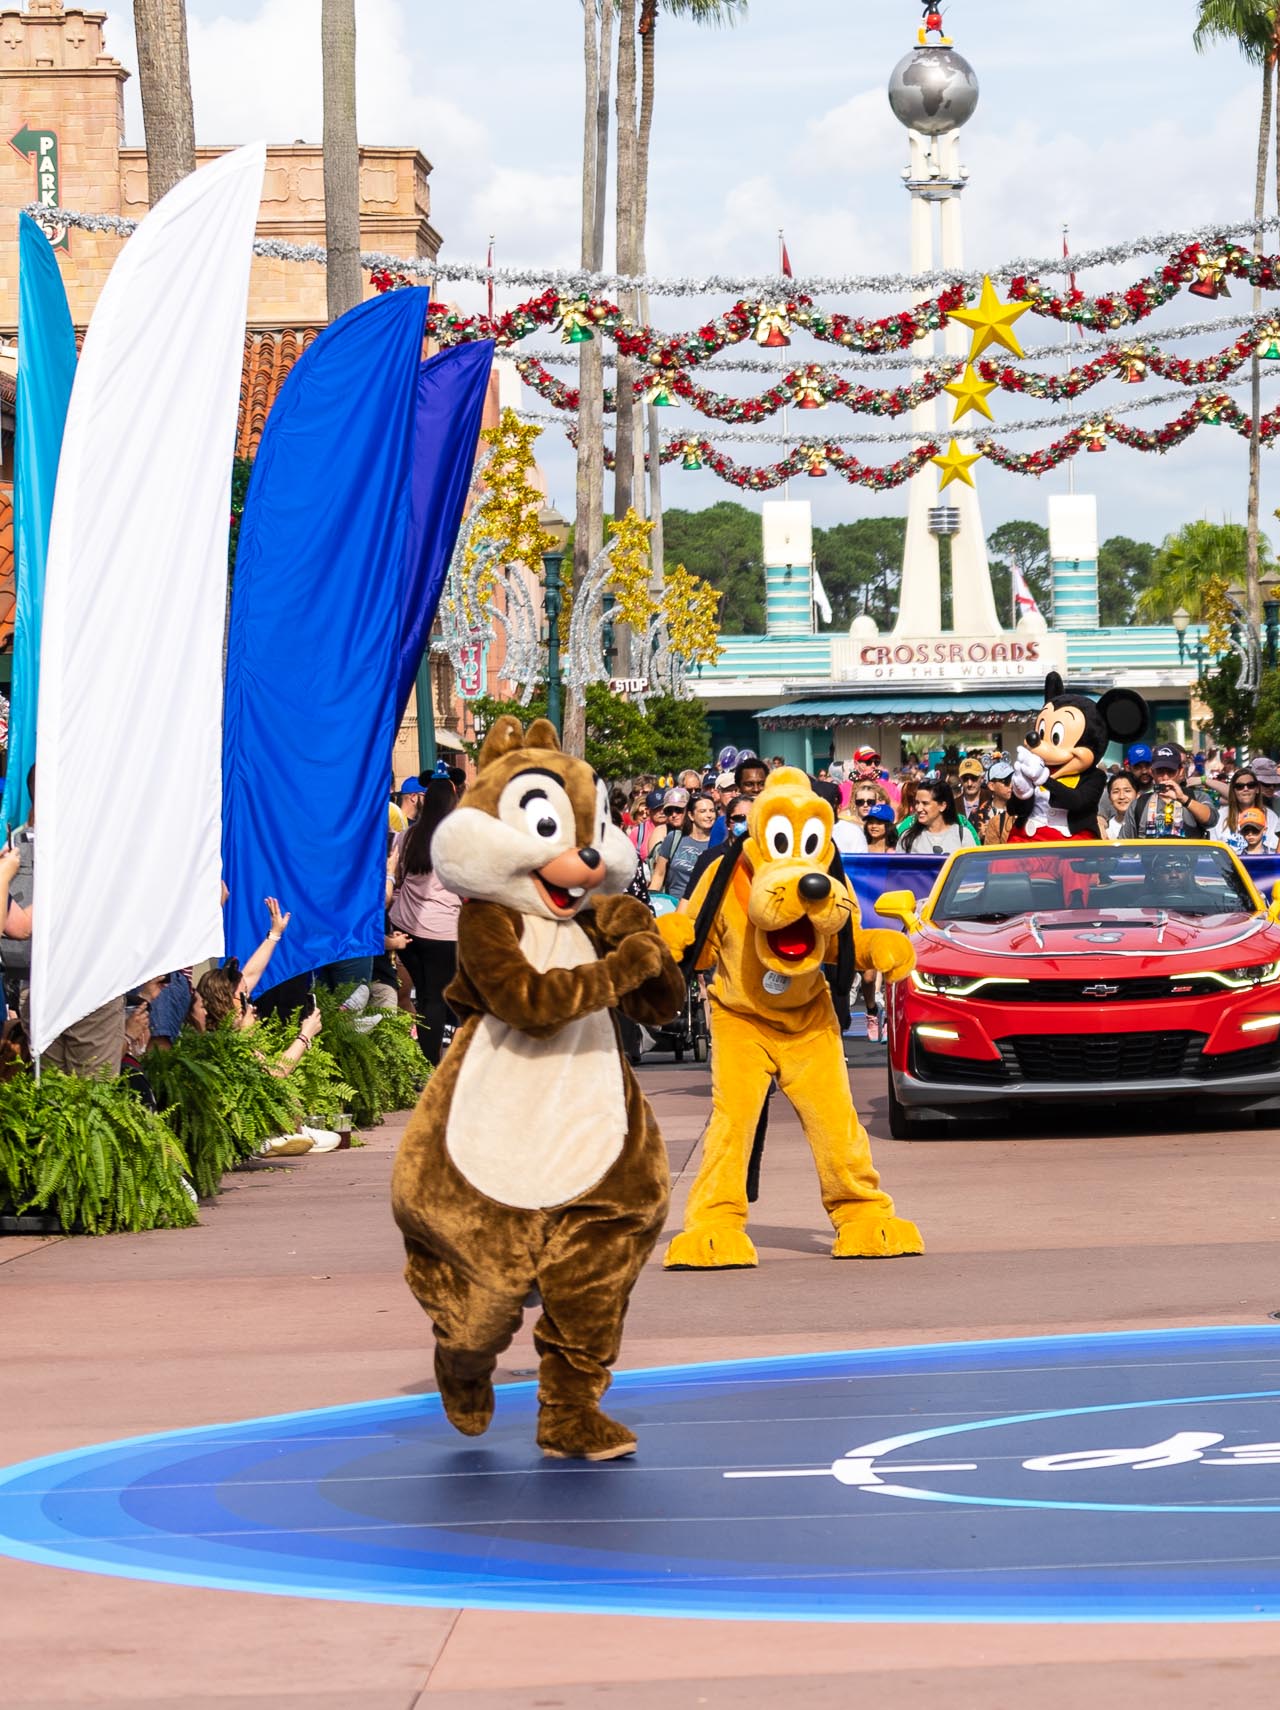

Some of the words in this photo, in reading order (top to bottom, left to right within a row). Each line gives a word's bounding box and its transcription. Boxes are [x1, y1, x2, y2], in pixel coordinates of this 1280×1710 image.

[39, 136, 57, 208] PARK
[859, 641, 1040, 666] CROSSROADS
[874, 668, 895, 678] OF
[911, 667, 945, 677] THE
[962, 664, 1025, 677] WORLD
[615, 678, 648, 693] STOP
